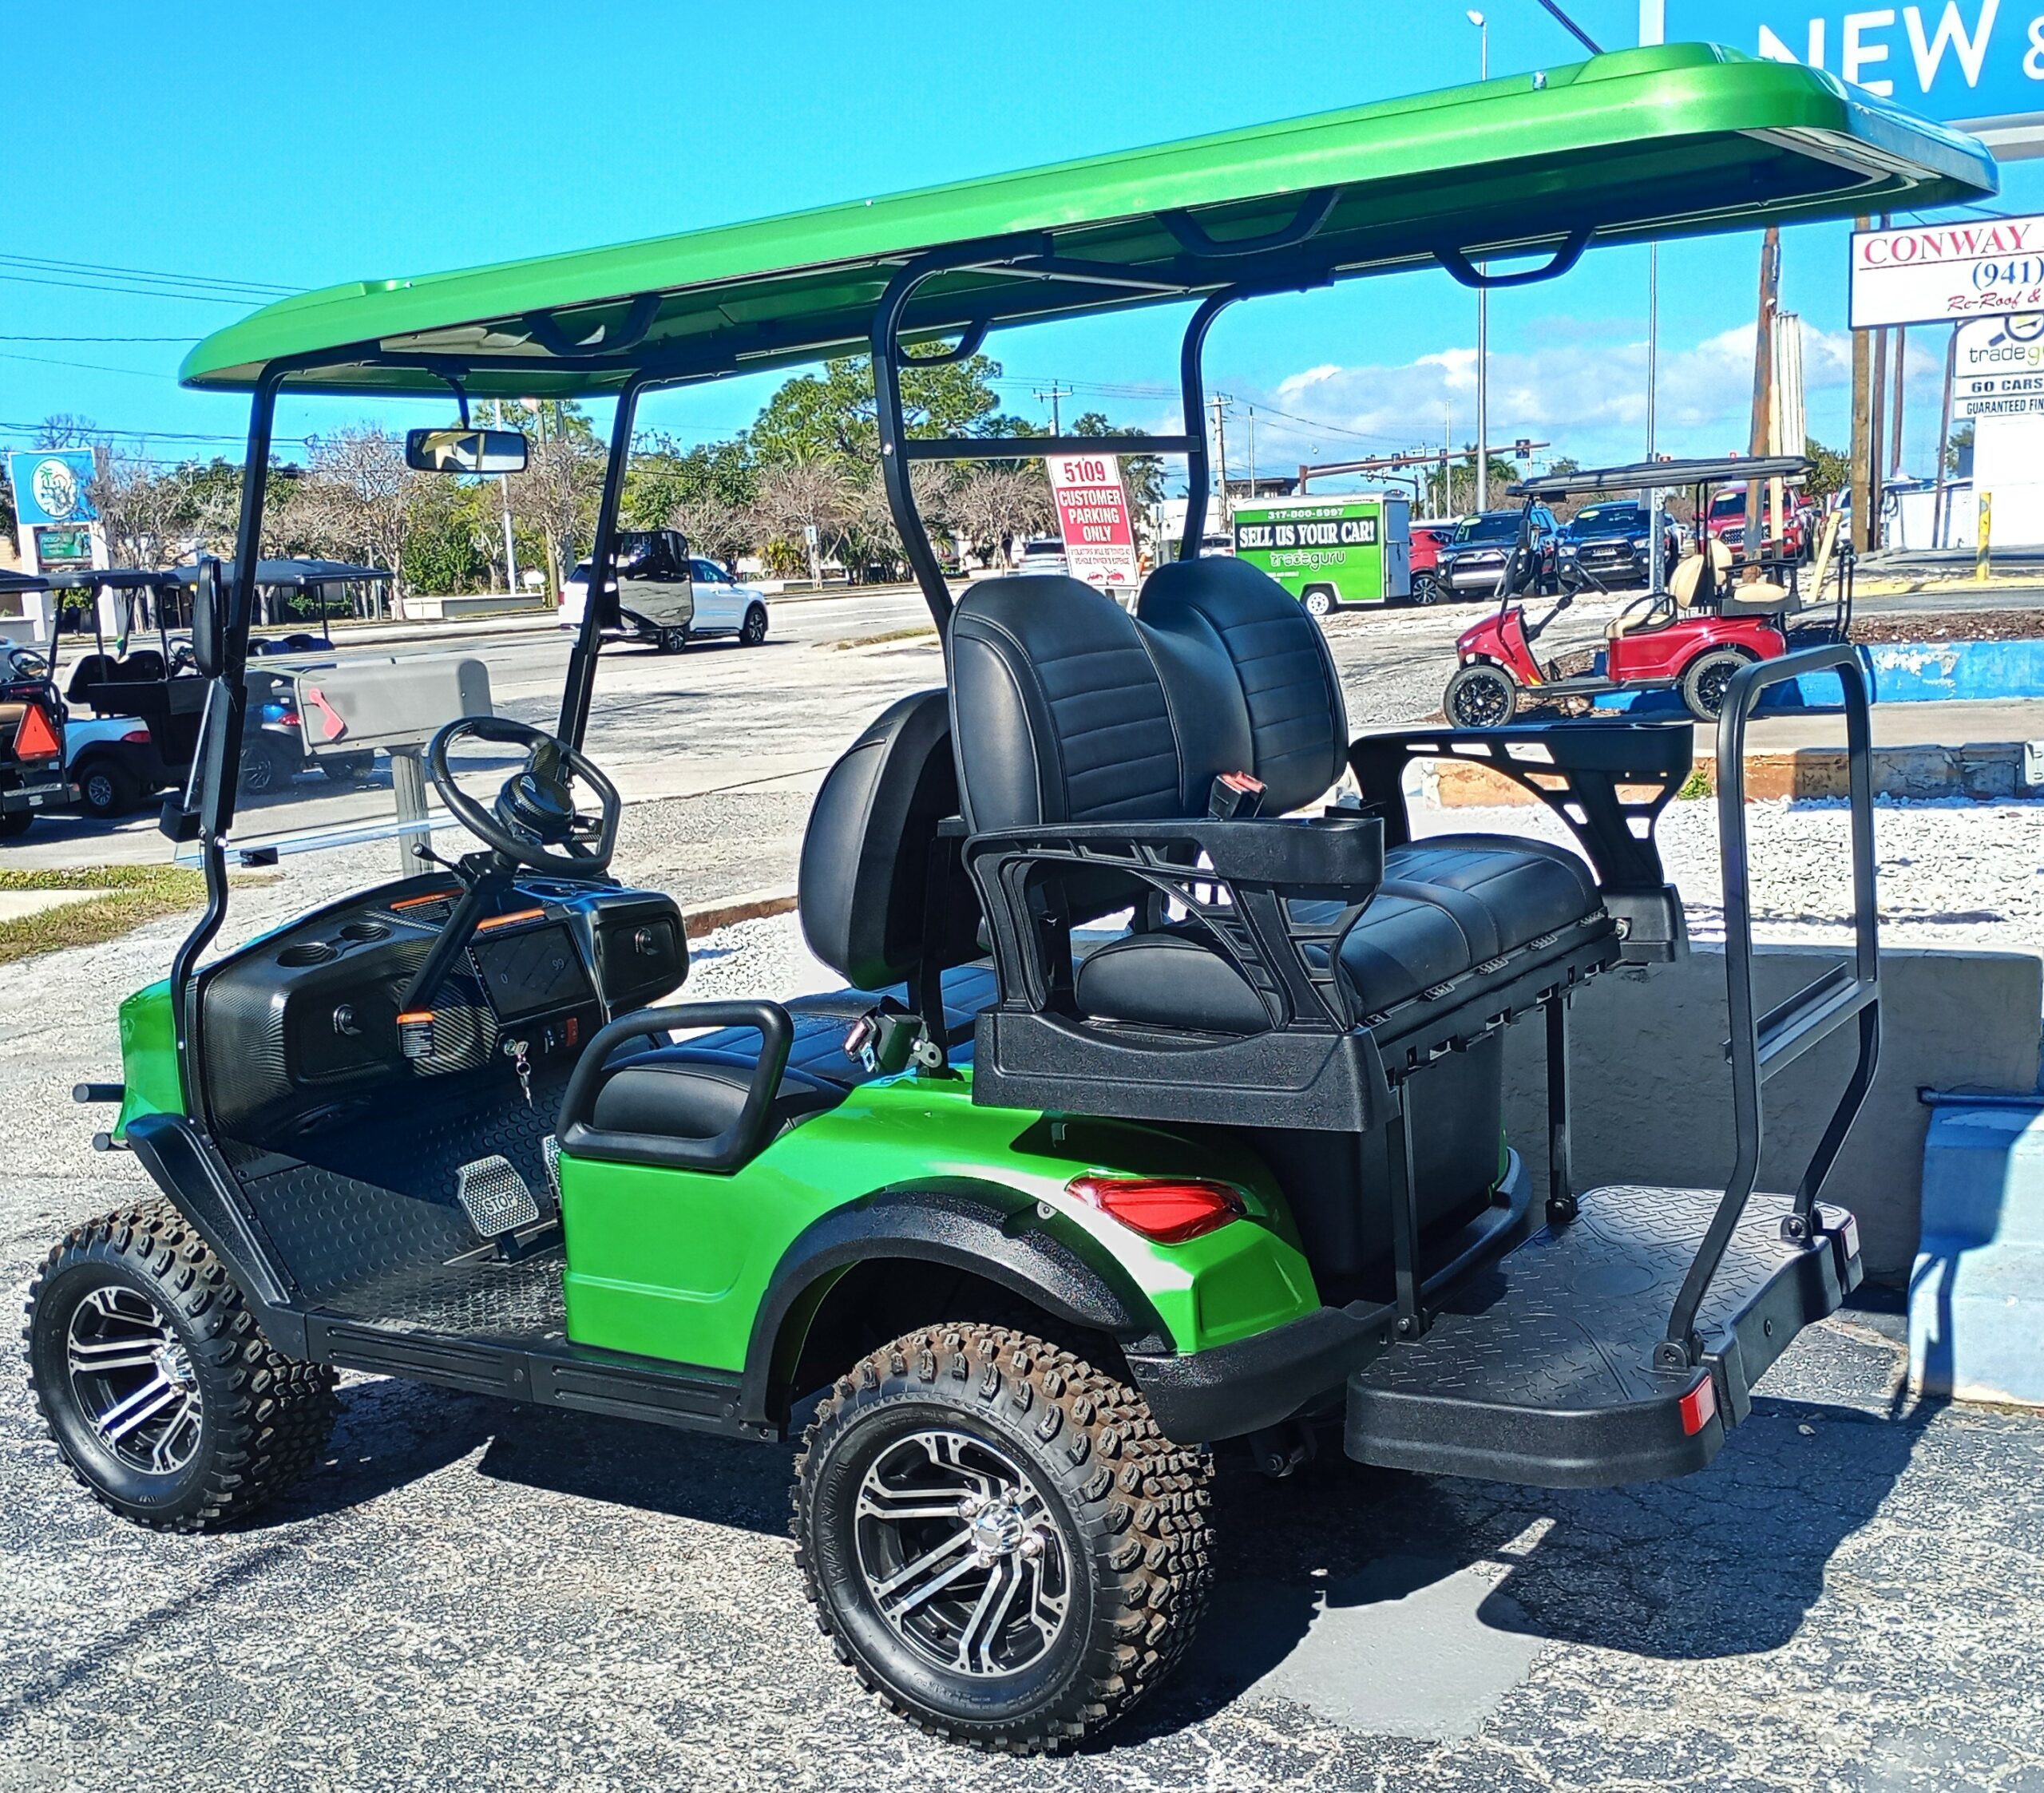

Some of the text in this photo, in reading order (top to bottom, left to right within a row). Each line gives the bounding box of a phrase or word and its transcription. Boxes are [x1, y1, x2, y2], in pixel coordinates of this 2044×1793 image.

[1864, 224, 2032, 264] CONWAY
[1972, 256, 2044, 291] (941)
[1947, 288, 2041, 311] Re-Roof &
[1969, 342, 2044, 366] tradeg
[2001, 378, 2043, 391] CARS
[1967, 399, 2026, 414] GUARANTEED
[1064, 461, 1107, 482] 5109
[1058, 489, 1123, 507] CUSTOMER
[1068, 507, 1120, 524] PARKING
[1083, 525, 1112, 542] ONLY
[1239, 520, 1375, 548] SELL US YOUR CAR!
[1270, 550, 1345, 570] tradeguru
[483, 1192, 515, 1213] STOP
